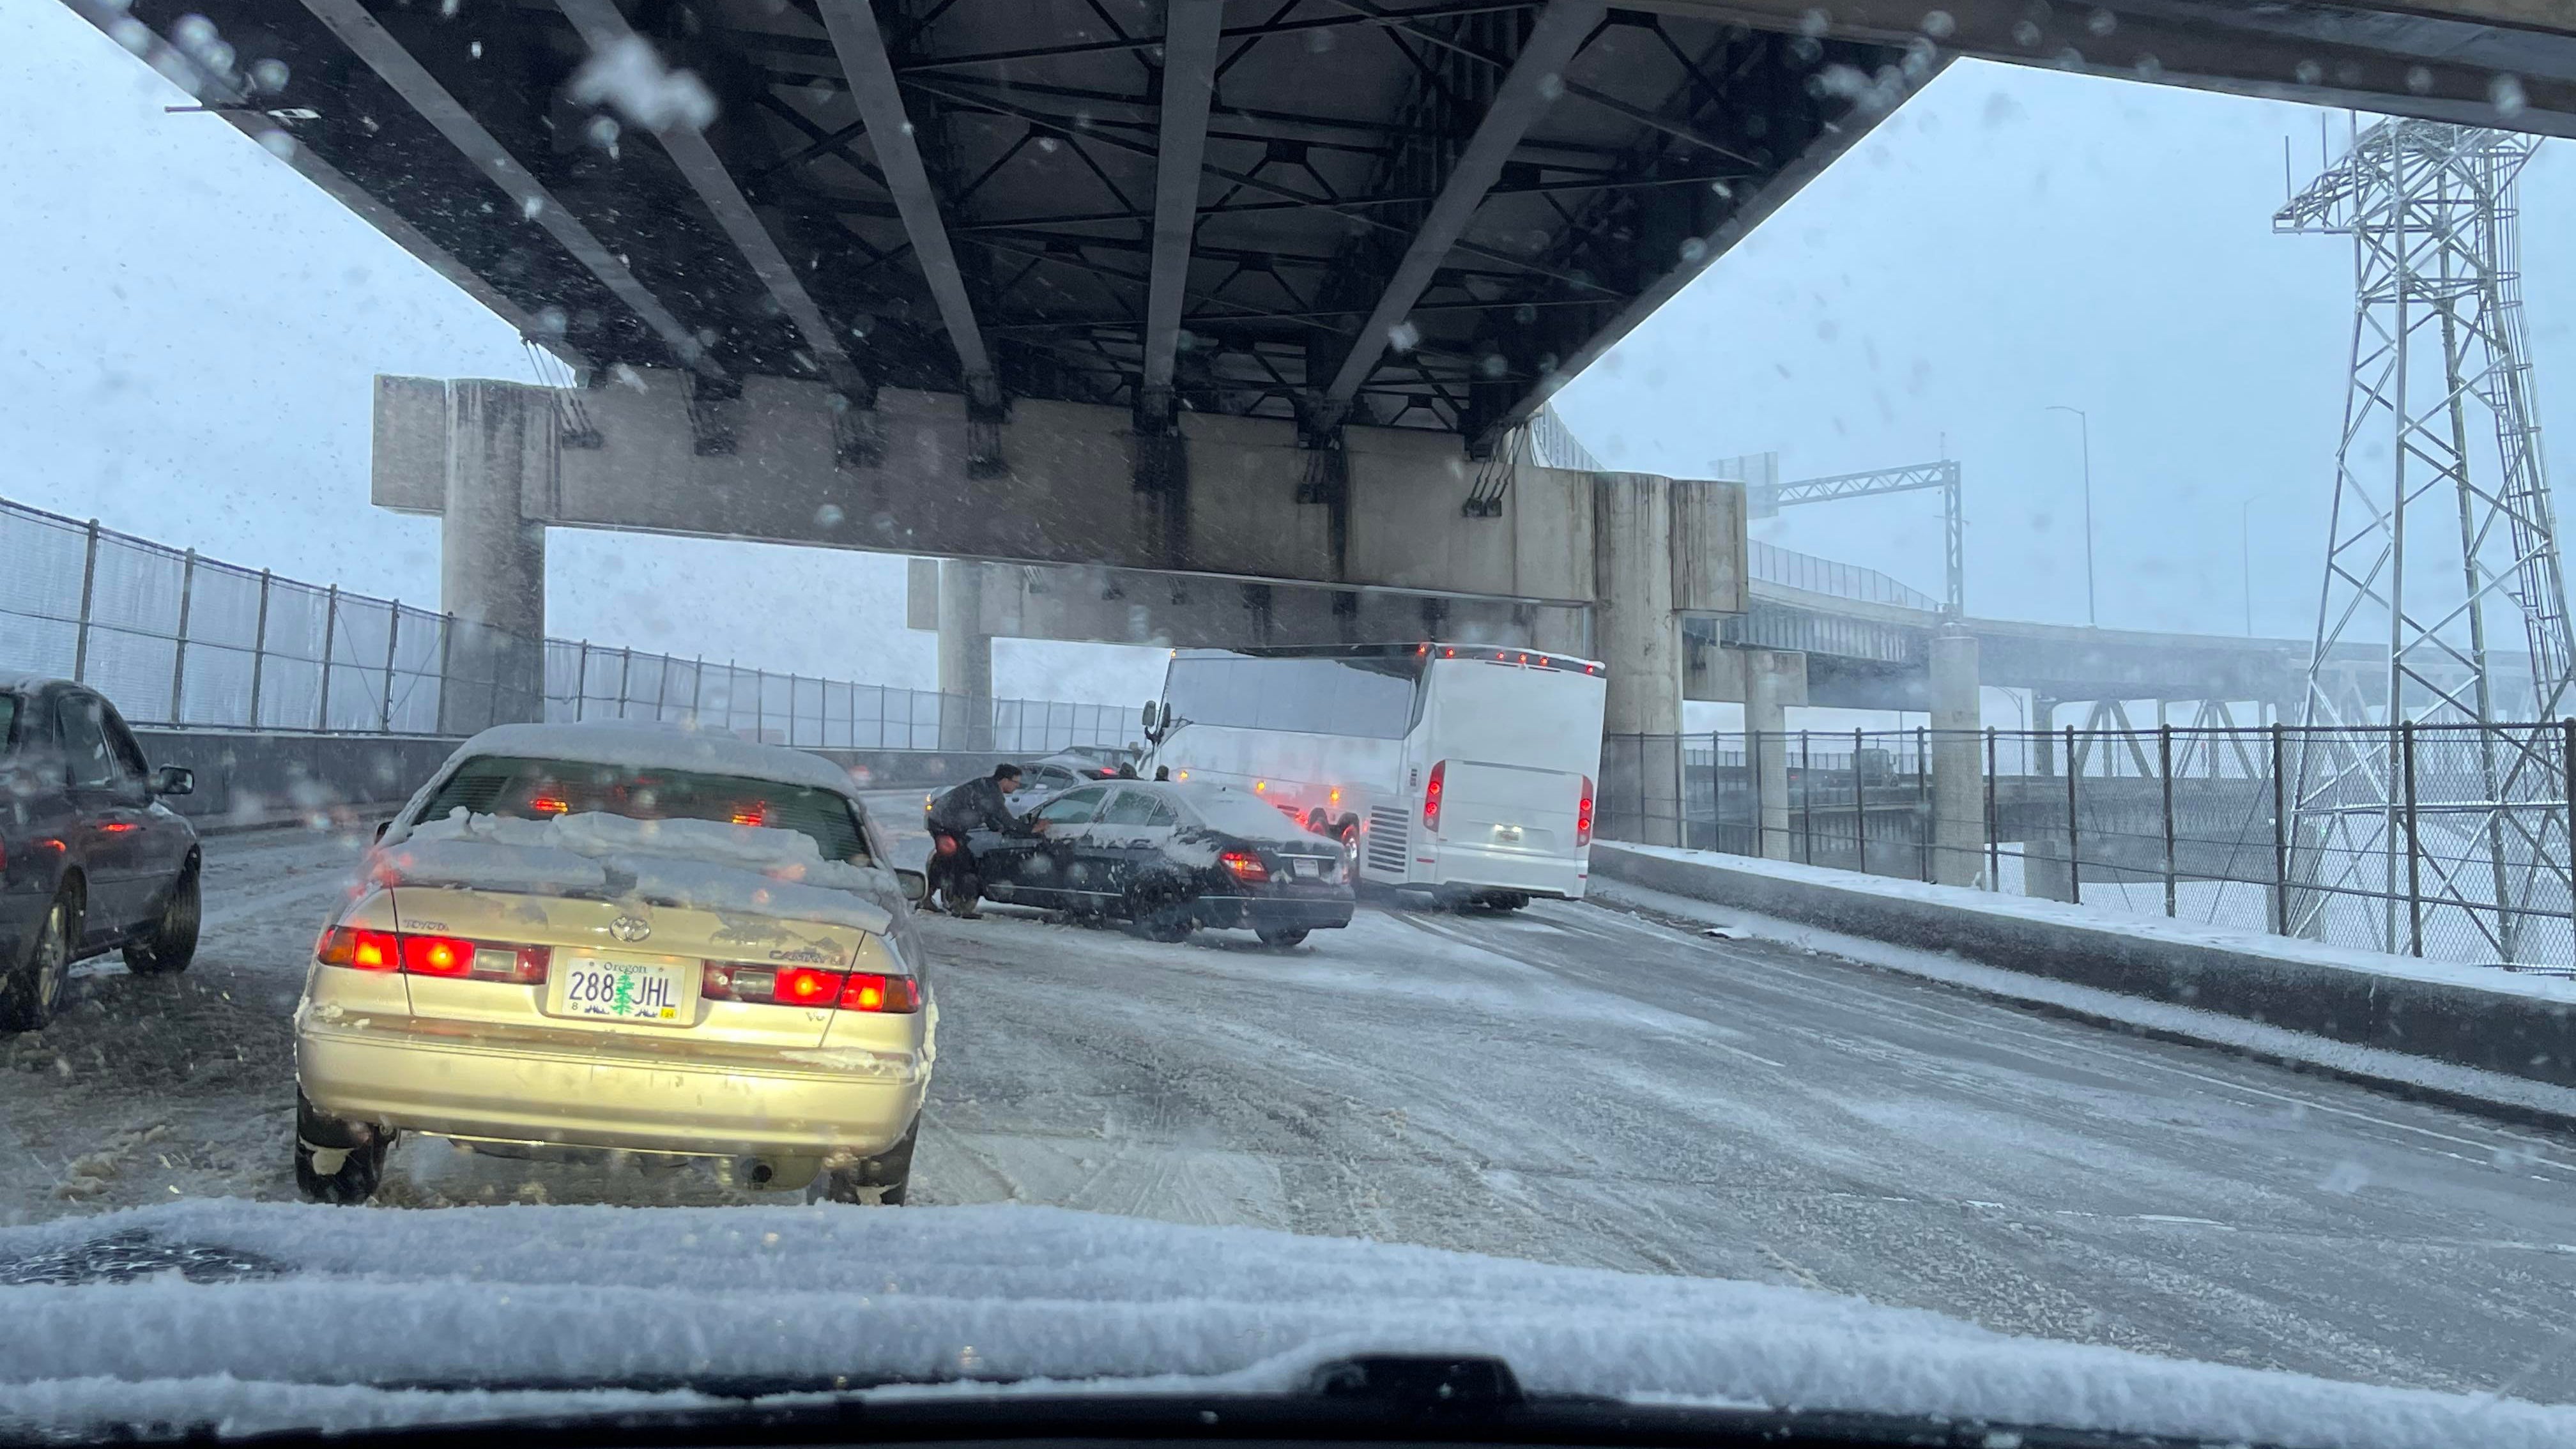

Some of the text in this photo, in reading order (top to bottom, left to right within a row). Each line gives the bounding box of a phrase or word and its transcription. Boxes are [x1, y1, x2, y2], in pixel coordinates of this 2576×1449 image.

[402, 919, 450, 931] TOYOTA
[769, 950, 828, 963] CAMRY
[604, 962, 647, 975] Oregon
[569, 971, 675, 1008] 288 JHL
[571, 1002, 578, 1011] 8
